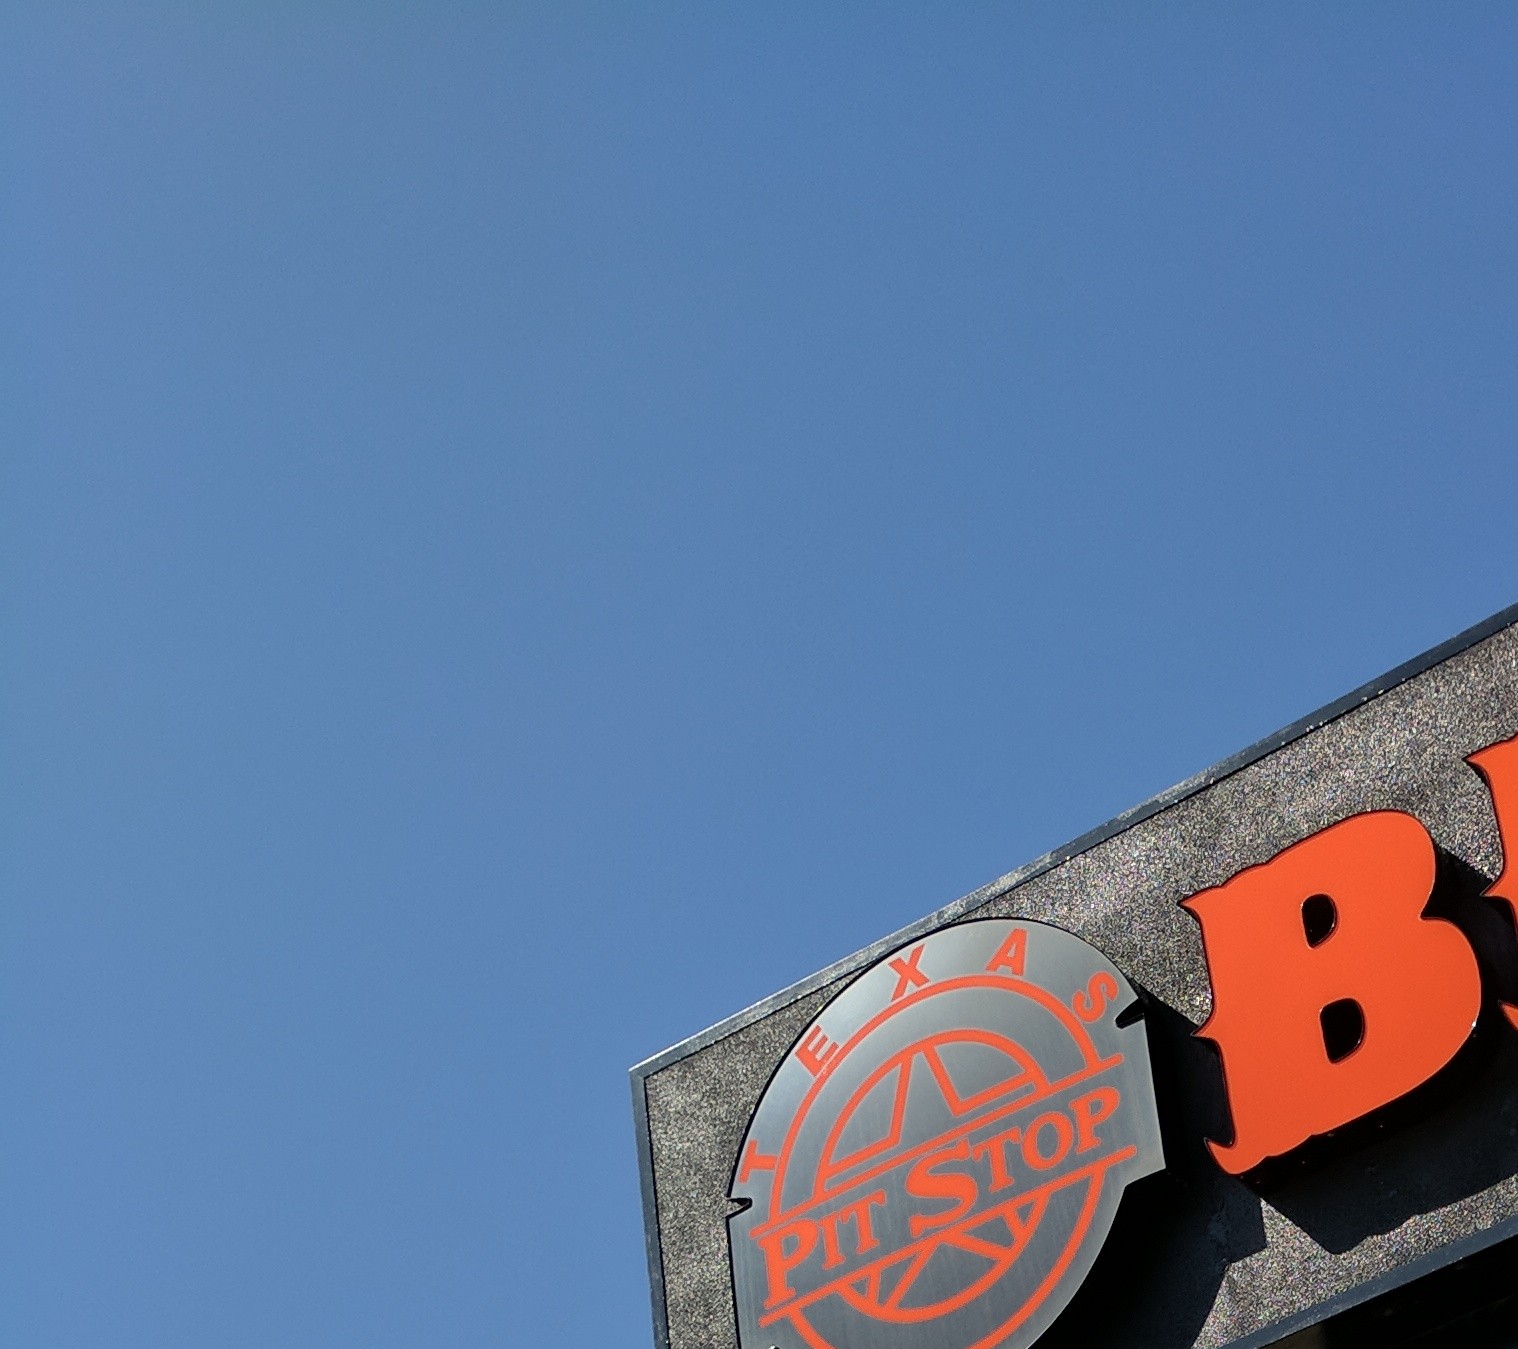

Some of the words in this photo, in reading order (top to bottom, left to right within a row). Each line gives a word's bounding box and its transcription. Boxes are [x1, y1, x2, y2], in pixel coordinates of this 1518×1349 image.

[738, 928, 1119, 1184] TEXAS
[757, 1190, 887, 1310] PIT
[905, 1086, 1121, 1237] STOP
